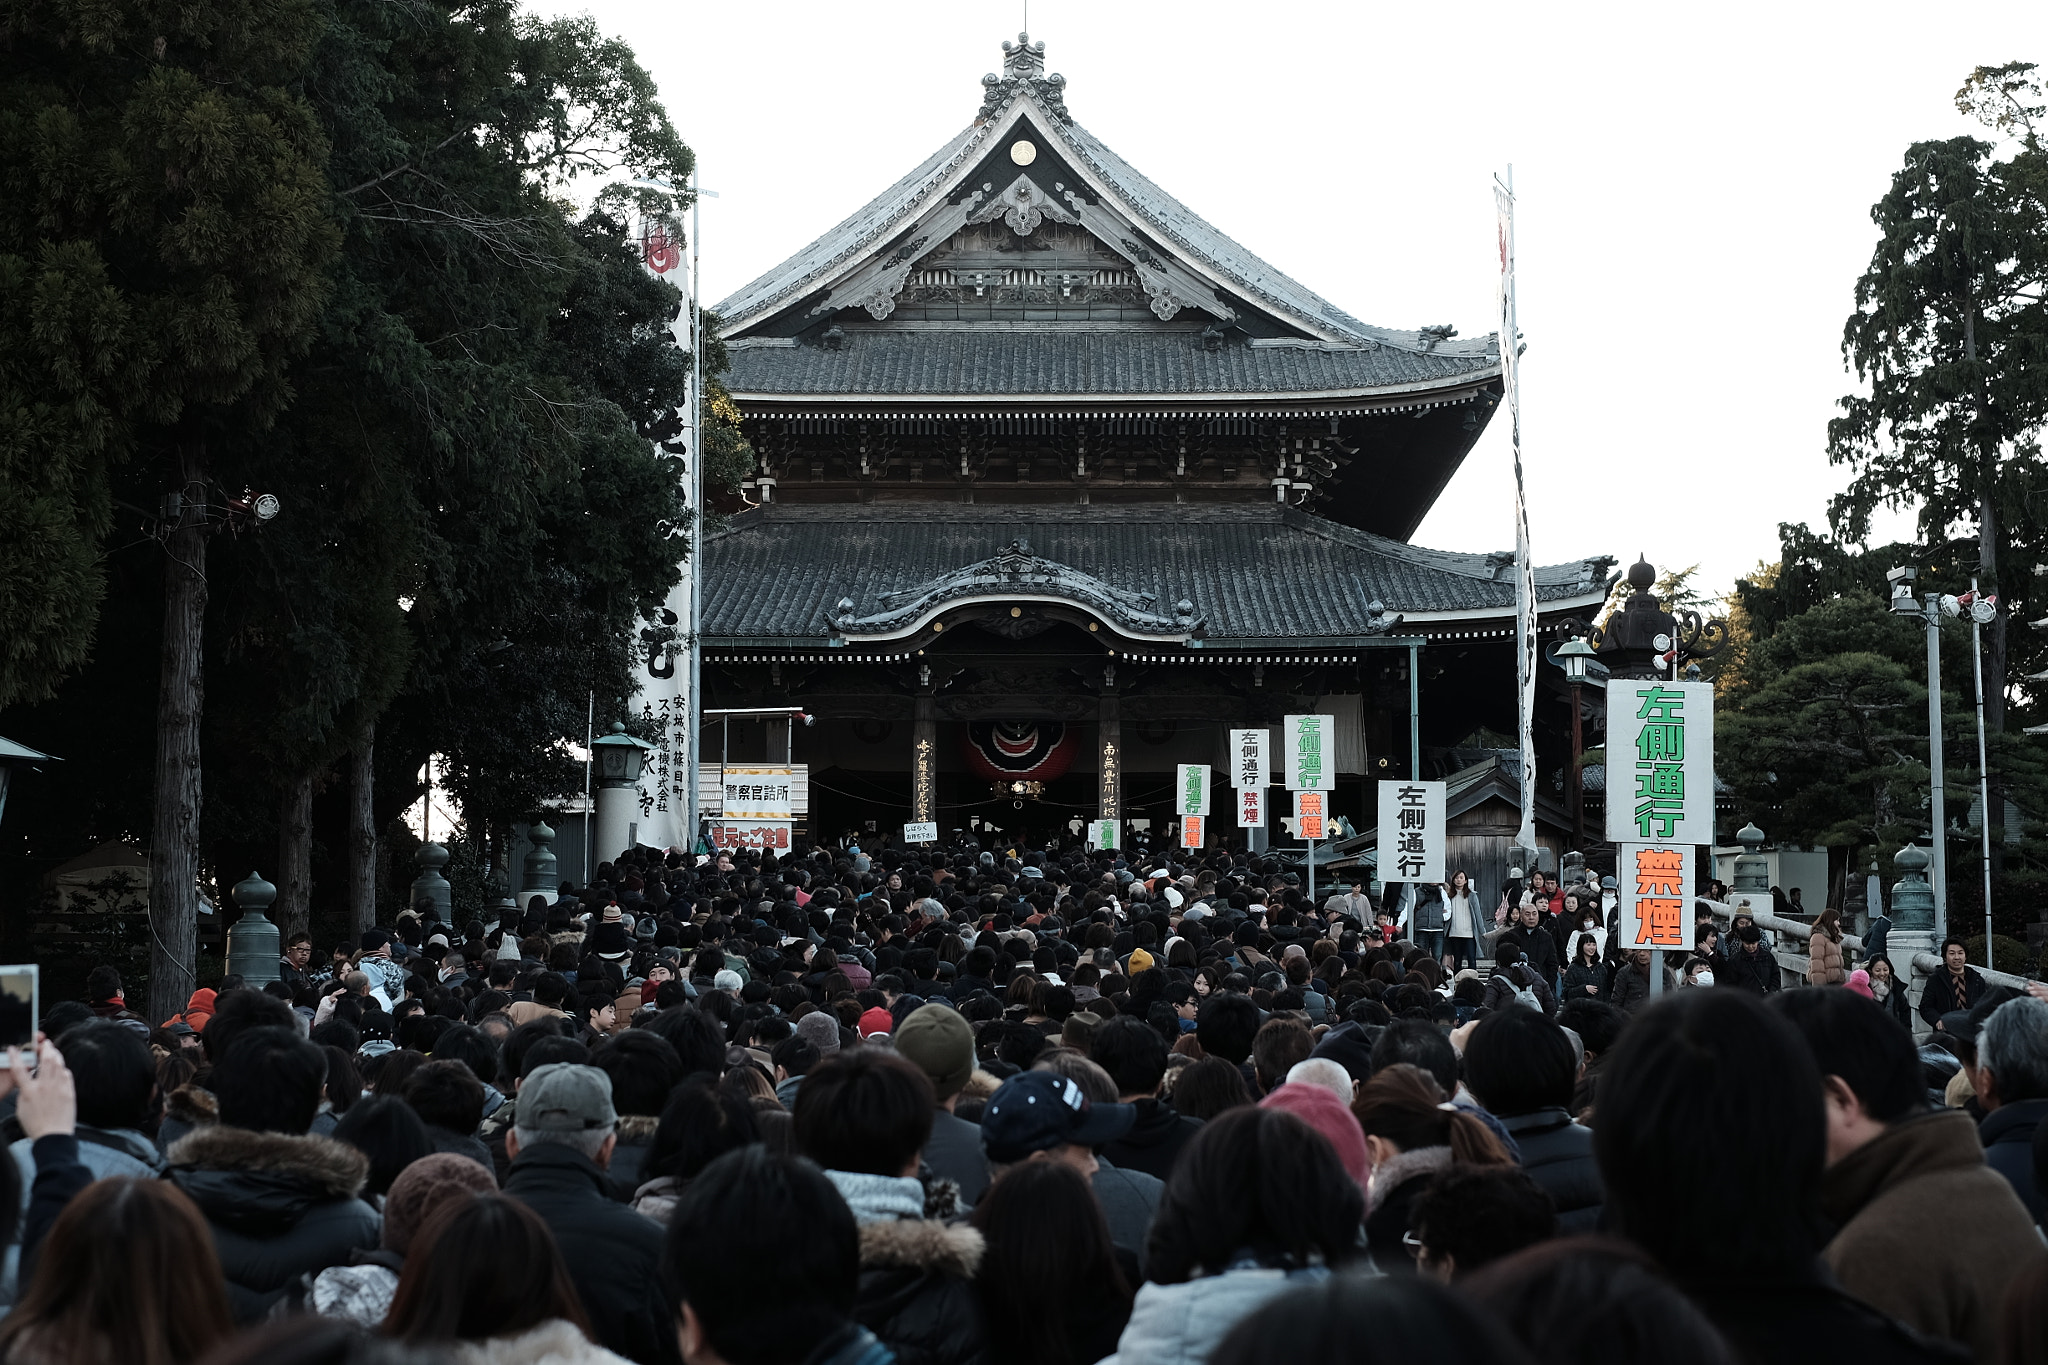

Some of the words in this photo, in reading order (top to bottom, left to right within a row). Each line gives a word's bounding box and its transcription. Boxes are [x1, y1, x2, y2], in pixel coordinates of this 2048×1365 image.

[672, 693, 686, 801] 安城市篠目町
[1241, 731, 1259, 786] 左側通行
[1297, 717, 1322, 788] 左側通行
[1635, 686, 1685, 838] 左側通行
[725, 784, 789, 802] 警察官詰所
[1185, 765, 1202, 814] 左側通行
[1243, 792, 1258, 823] 禁煙
[711, 826, 789, 849] 足元にご注意
[906, 832, 936, 840] お待ち下さい
[1184, 816, 1201, 847] 禁煙
[1299, 793, 1323, 838] 禁煙
[1396, 785, 1427, 878] 左側通行
[1635, 848, 1683, 946] 禁煙
